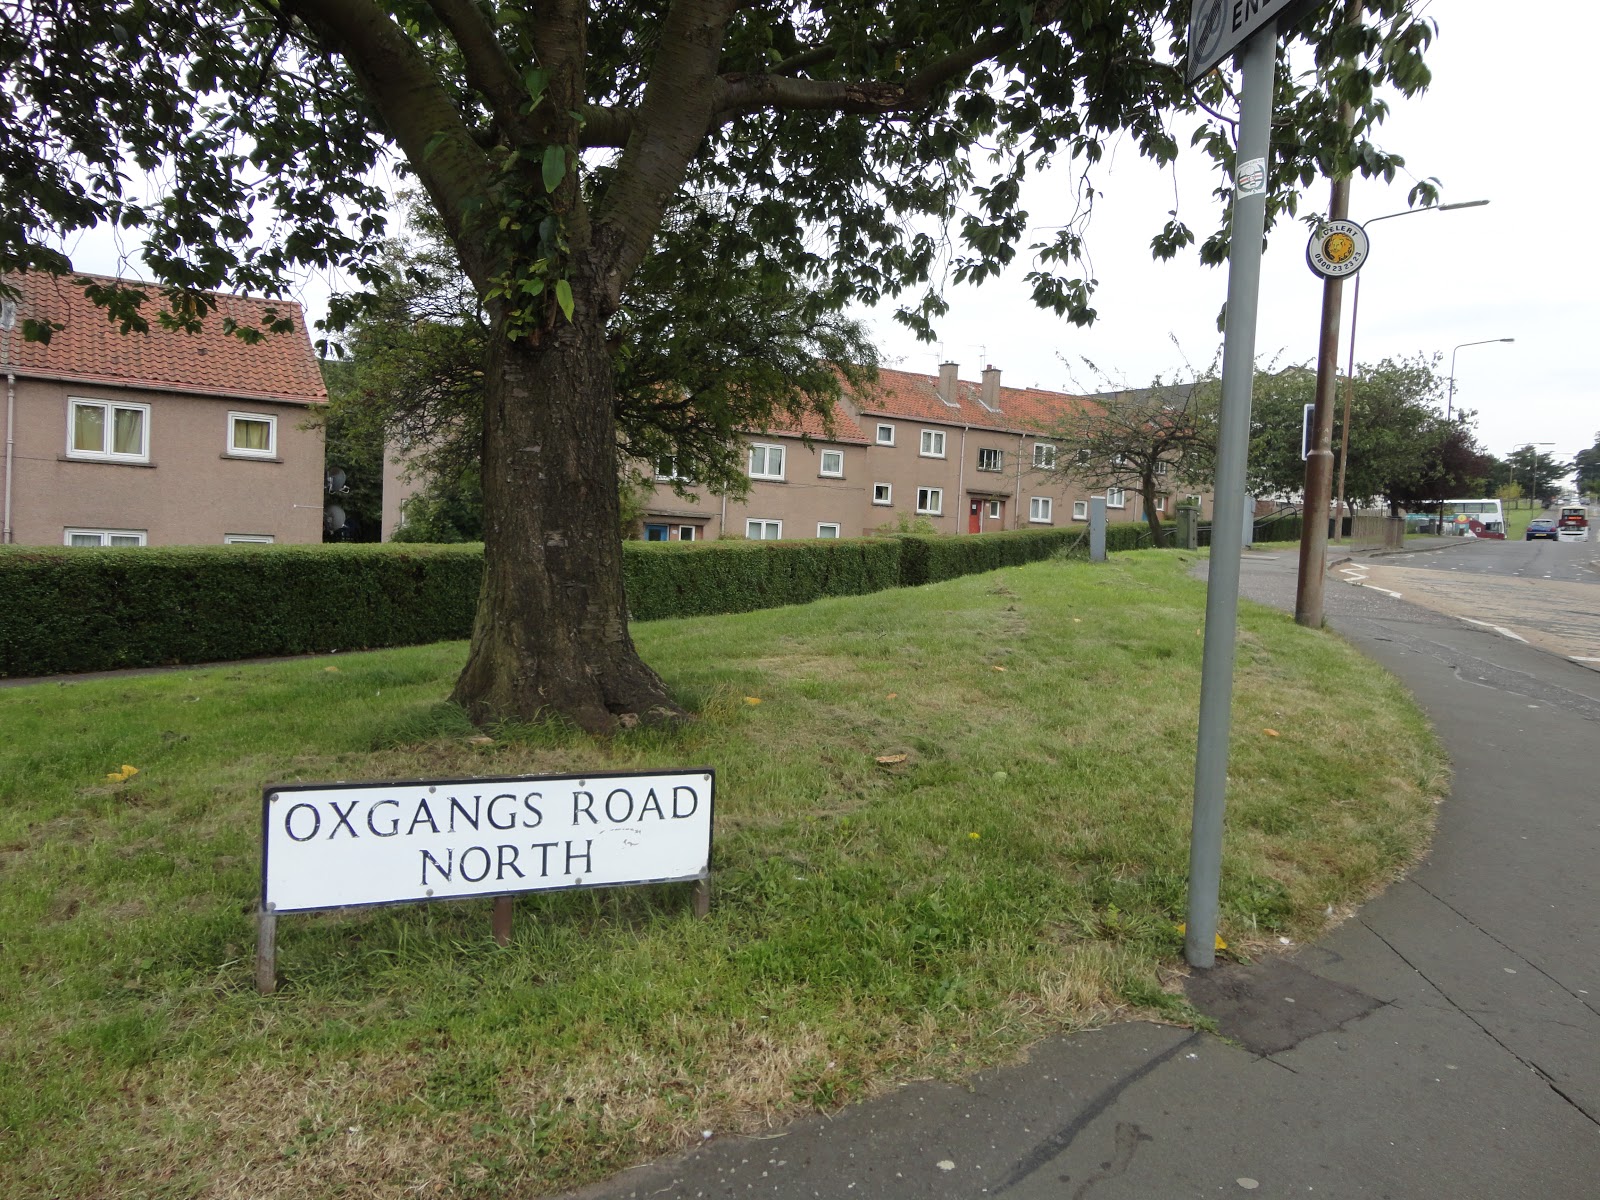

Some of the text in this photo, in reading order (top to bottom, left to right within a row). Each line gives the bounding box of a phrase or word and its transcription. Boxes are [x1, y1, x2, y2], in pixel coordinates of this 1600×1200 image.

[1231, 0, 1271, 33] EN
[1314, 253, 1331, 270] 0800
[1344, 260, 1354, 270] 23
[1352, 251, 1362, 262] 23
[284, 785, 698, 842] OXGANGS ROAD
[419, 839, 594, 886] NORTH
